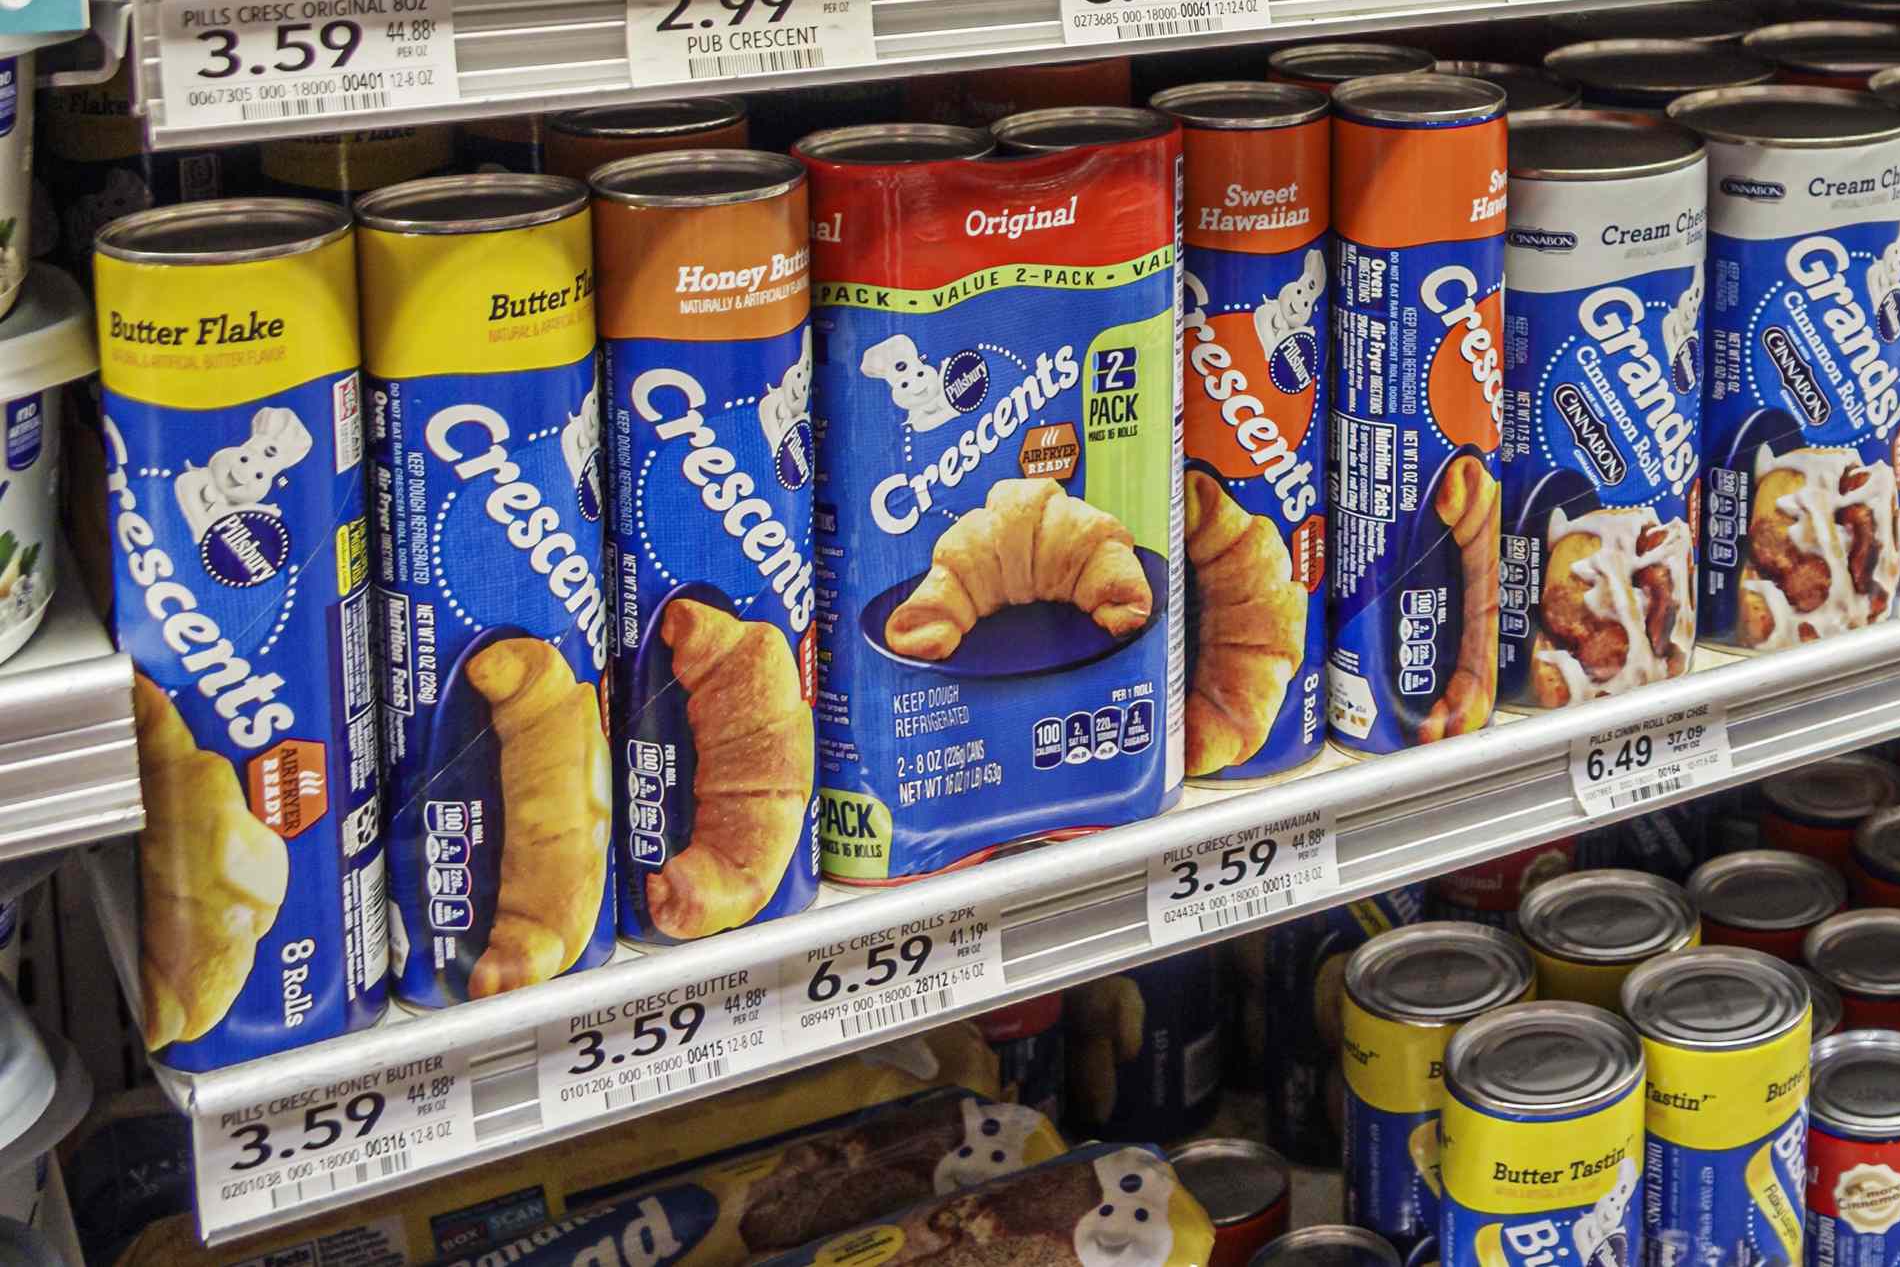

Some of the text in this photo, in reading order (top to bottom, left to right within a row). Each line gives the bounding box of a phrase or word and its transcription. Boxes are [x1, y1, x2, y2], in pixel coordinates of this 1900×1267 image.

[183, 7, 231, 27] PILLS
[237, 2, 294, 24] CRESC
[196, 20, 363, 78] 3.59
[687, 26, 818, 54] PUB CRESCENT
[188, 88, 253, 106] 0067305
[1224, 184, 1297, 207] Sweet
[1809, 175, 1874, 197] Cream
[965, 196, 1078, 240] Original
[1199, 206, 1310, 232] Hawaiian
[1602, 221, 1670, 246] Cream
[677, 261, 763, 293] Honey
[489, 283, 569, 320] Butter
[110, 312, 284, 346] Butter Flake
[1088, 395, 1137, 427] PACK
[870, 344, 1079, 534] Crescents
[1587, 735, 1652, 781] 6.49
[1163, 810, 1320, 864] PILLS CRESC SWT HAWAIIAN
[1170, 838, 1278, 900] 3.59
[807, 905, 976, 963] PILLS CRESC ROLLS 2PK
[807, 935, 933, 1003] 6.59
[569, 970, 749, 1032] PILLS CRESC BUTTER
[568, 1001, 706, 1076] 3.59
[221, 1055, 444, 1129] PILLS CRESC HONEY BUTTER
[560, 1075, 614, 1102] 0101206
[230, 1091, 386, 1170] 3.59
[1493, 1162, 1565, 1185] Butter
